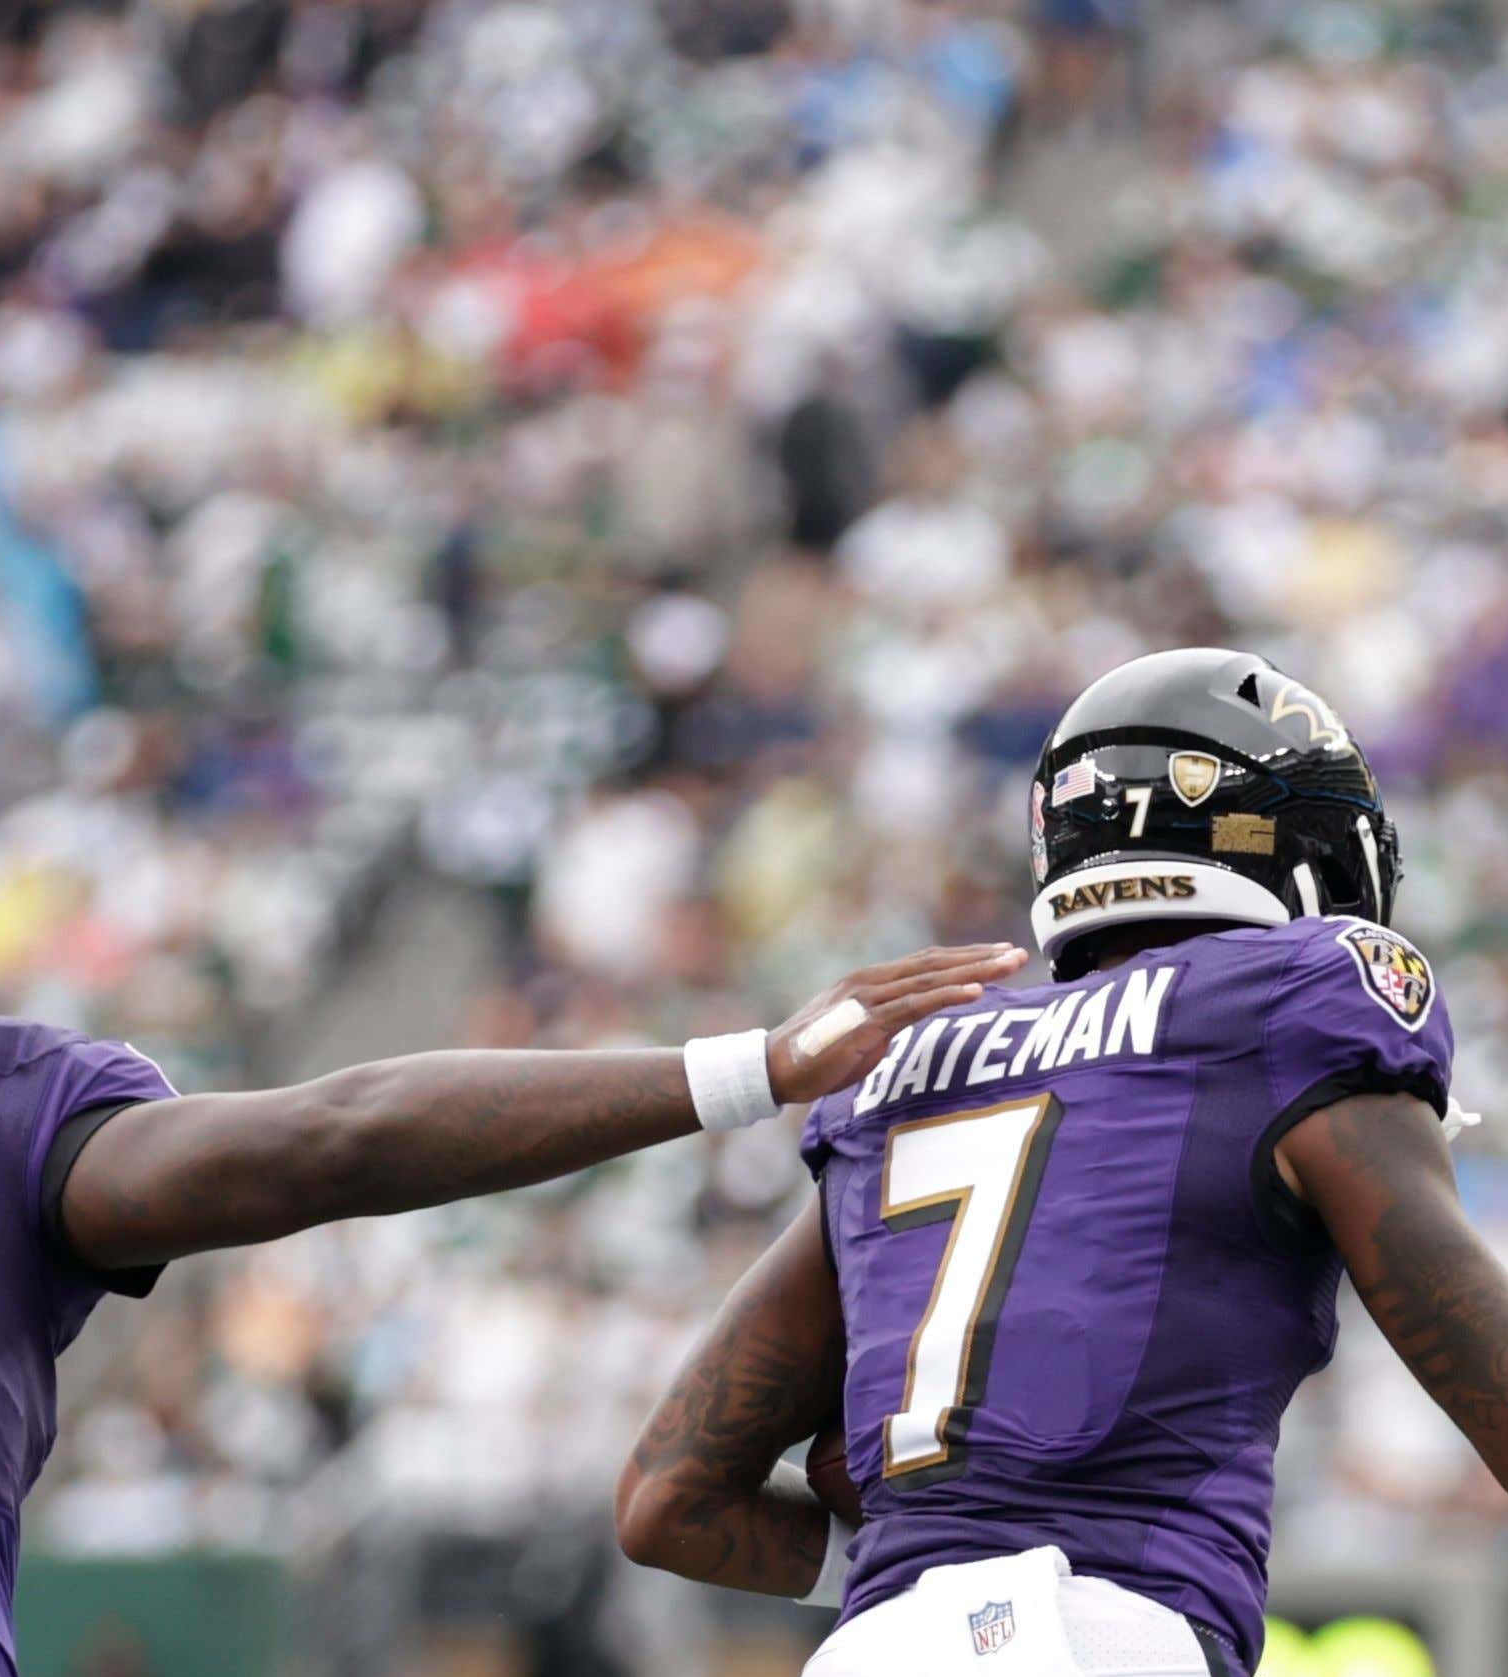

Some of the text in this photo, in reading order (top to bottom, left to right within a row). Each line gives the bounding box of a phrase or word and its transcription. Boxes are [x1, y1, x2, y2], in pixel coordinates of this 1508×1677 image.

[1125, 787, 1152, 838] 7
[1048, 876, 1197, 921] RAVENS
[852, 967, 1175, 1116] BATEMAN
[880, 1093, 1061, 1486] 7
[977, 1620, 1013, 1651] NFL
